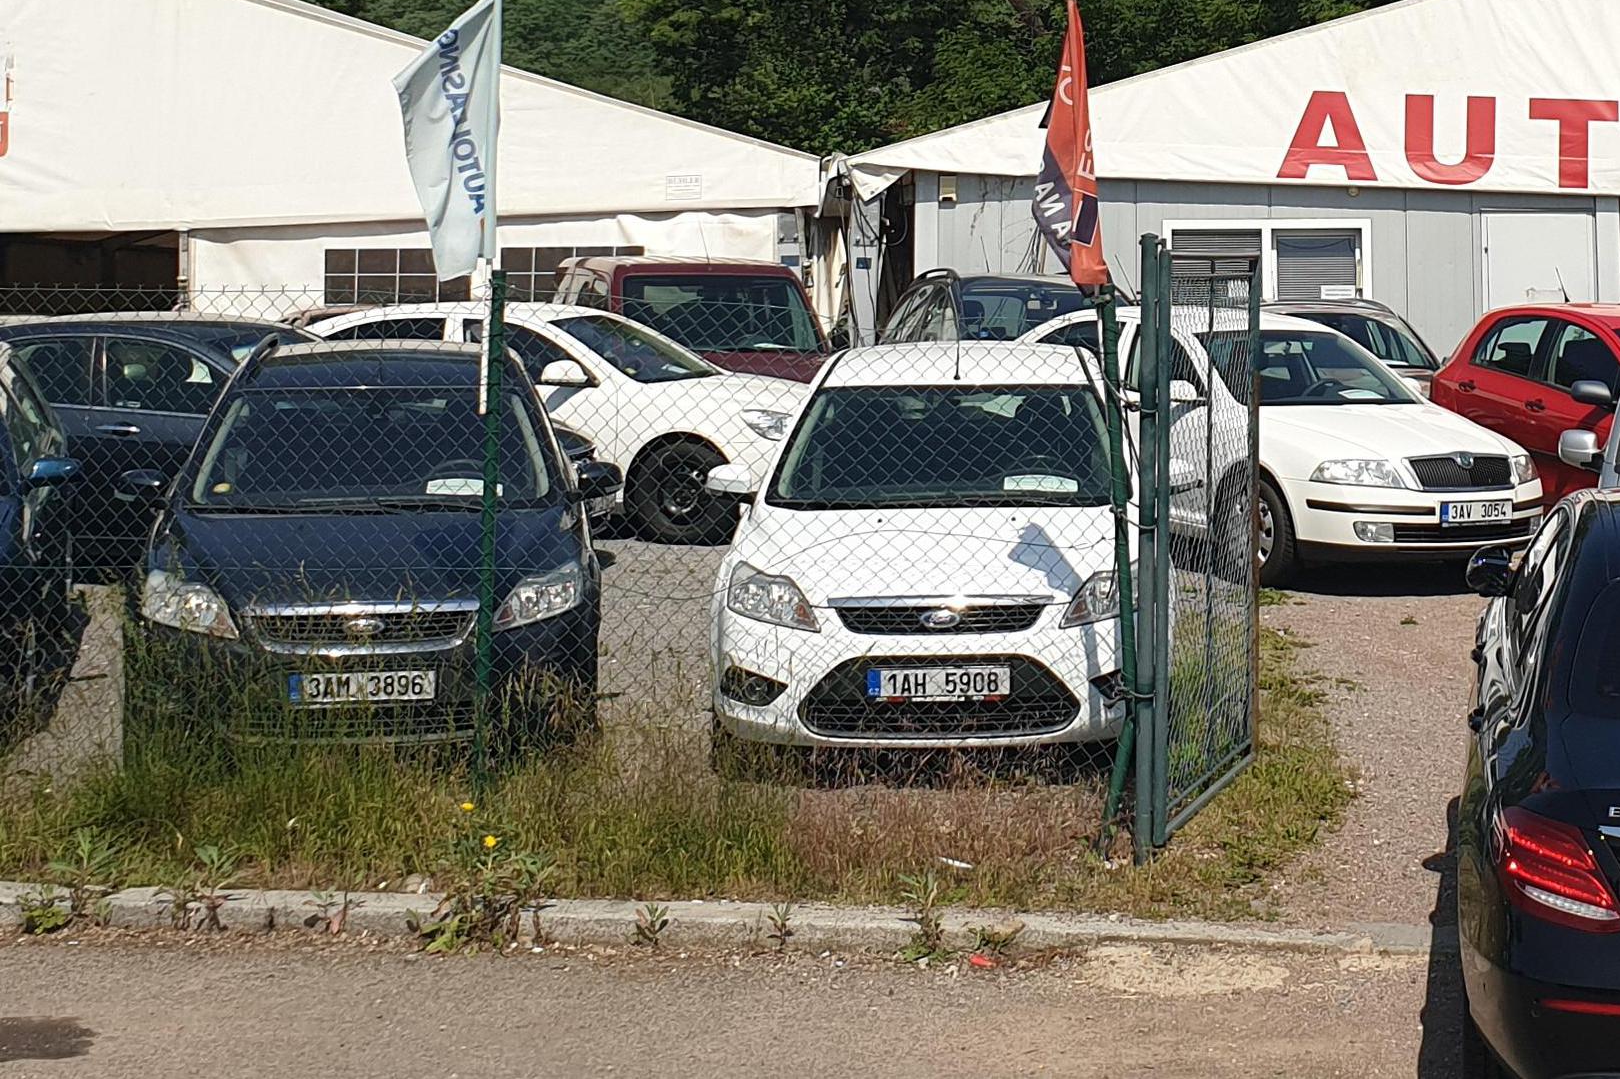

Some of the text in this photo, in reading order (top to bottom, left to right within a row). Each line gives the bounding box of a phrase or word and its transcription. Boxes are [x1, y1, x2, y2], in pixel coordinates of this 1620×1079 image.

[1451, 503, 1507, 520] 3AV 3054
[308, 674, 424, 699] 3AM 3896
[887, 672, 927, 695] 1AH
[945, 671, 999, 694] 5908
